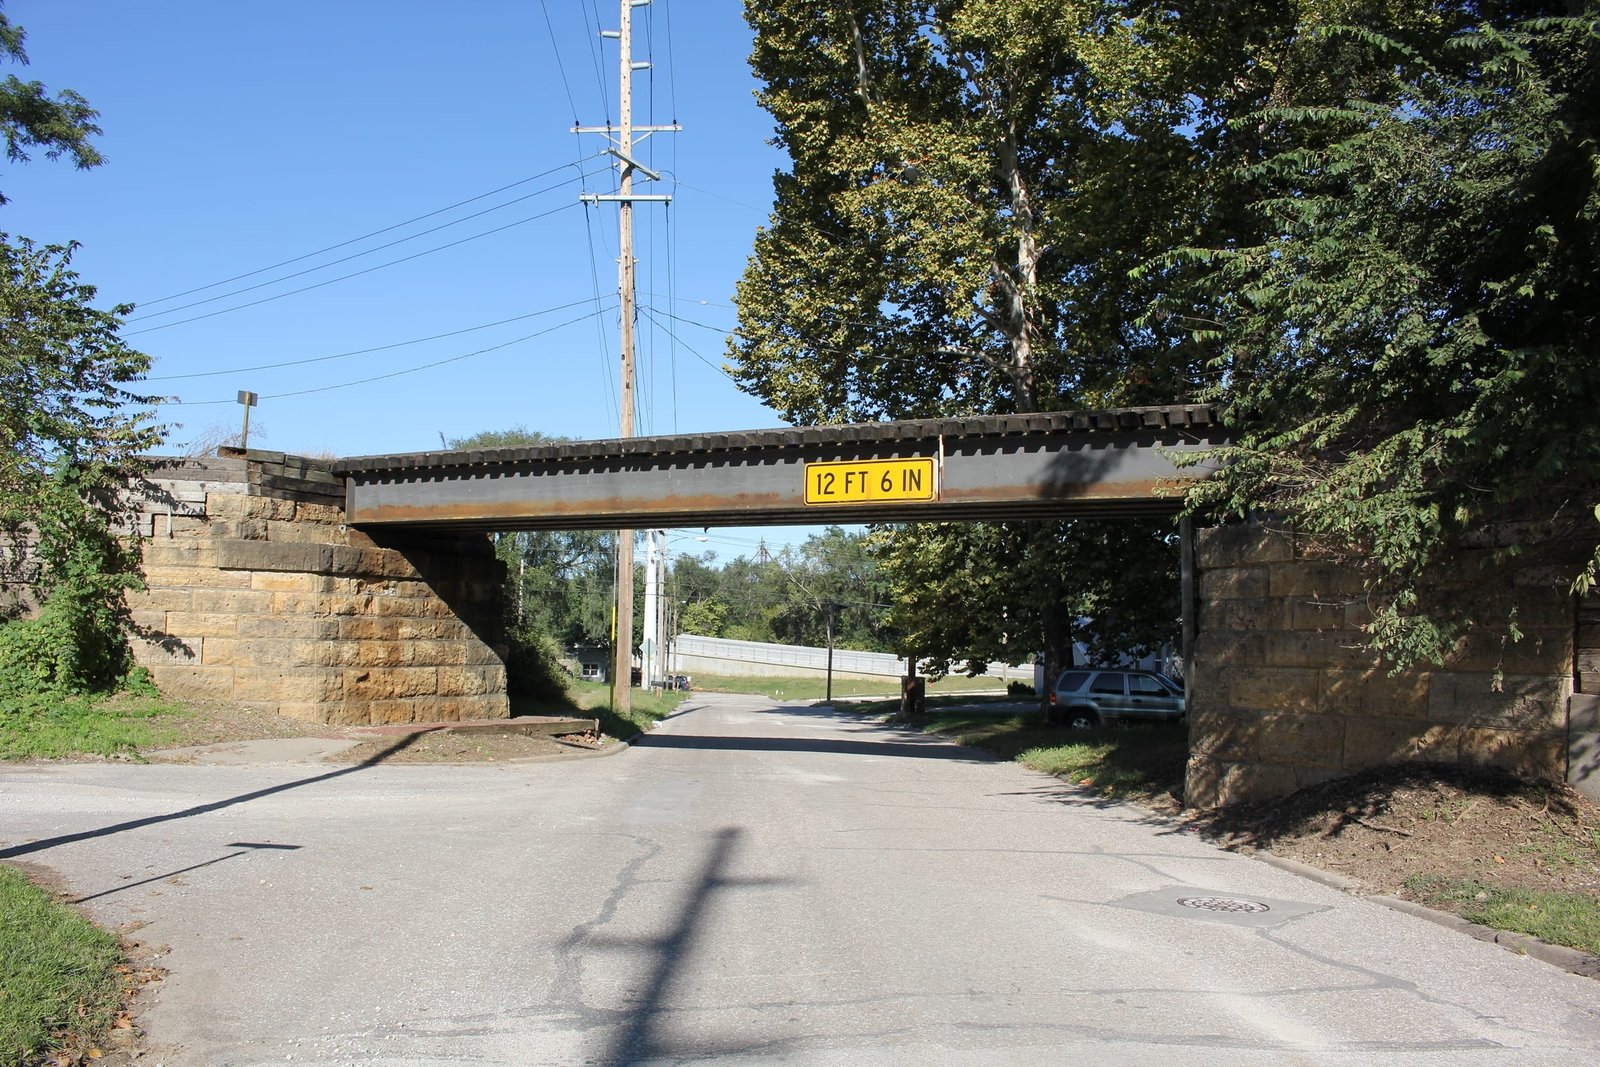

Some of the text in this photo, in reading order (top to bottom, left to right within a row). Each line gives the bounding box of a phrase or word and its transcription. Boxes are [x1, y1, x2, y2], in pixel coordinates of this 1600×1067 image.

[816, 468, 921, 495] 12 FT 6 IN
